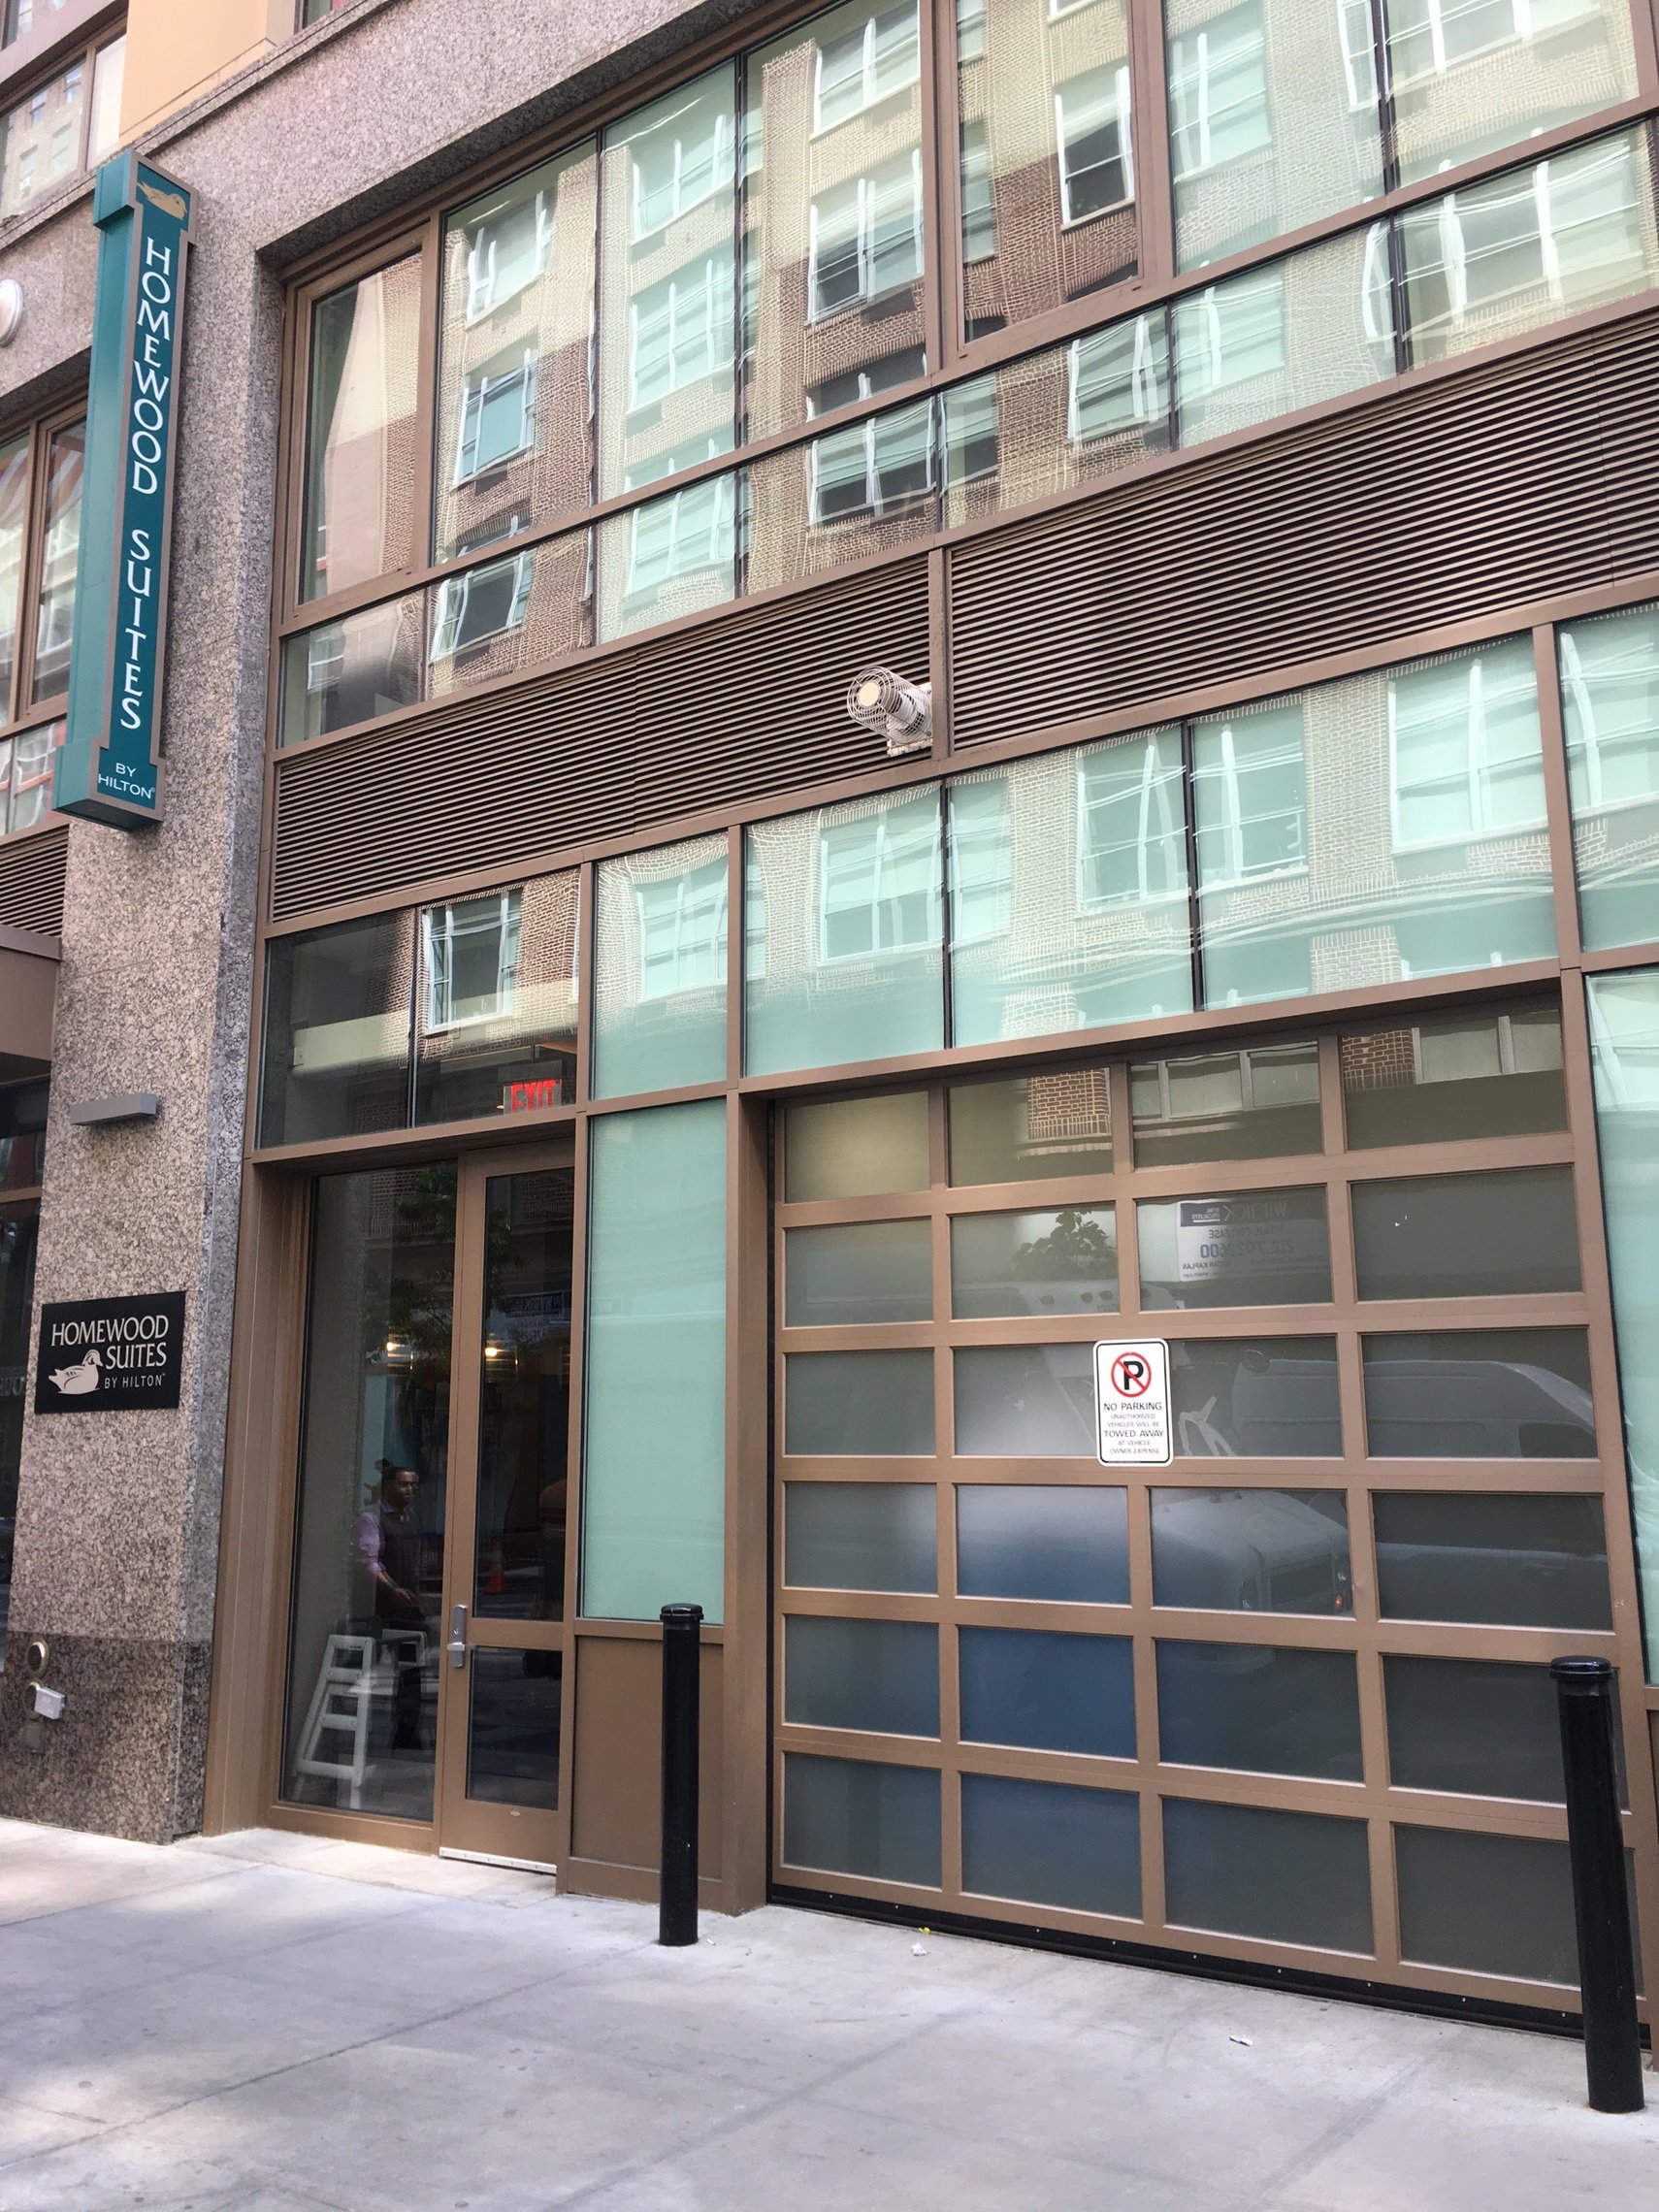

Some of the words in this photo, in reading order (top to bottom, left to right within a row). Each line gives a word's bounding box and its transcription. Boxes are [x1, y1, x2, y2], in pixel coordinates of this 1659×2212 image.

[131, 236, 172, 495] HOMEWOOD
[119, 529, 152, 730] SUITES
[115, 763, 137, 777] BY
[510, 1078, 557, 1113] EXIT
[50, 1315, 169, 1347] HOMEWOOD
[105, 1342, 167, 1370] SUITES
[104, 1378, 117, 1389] BY
[122, 1375, 163, 1388] HILTON
[1103, 1403, 1118, 1412] NO
[1121, 1402, 1162, 1411] PARKING
